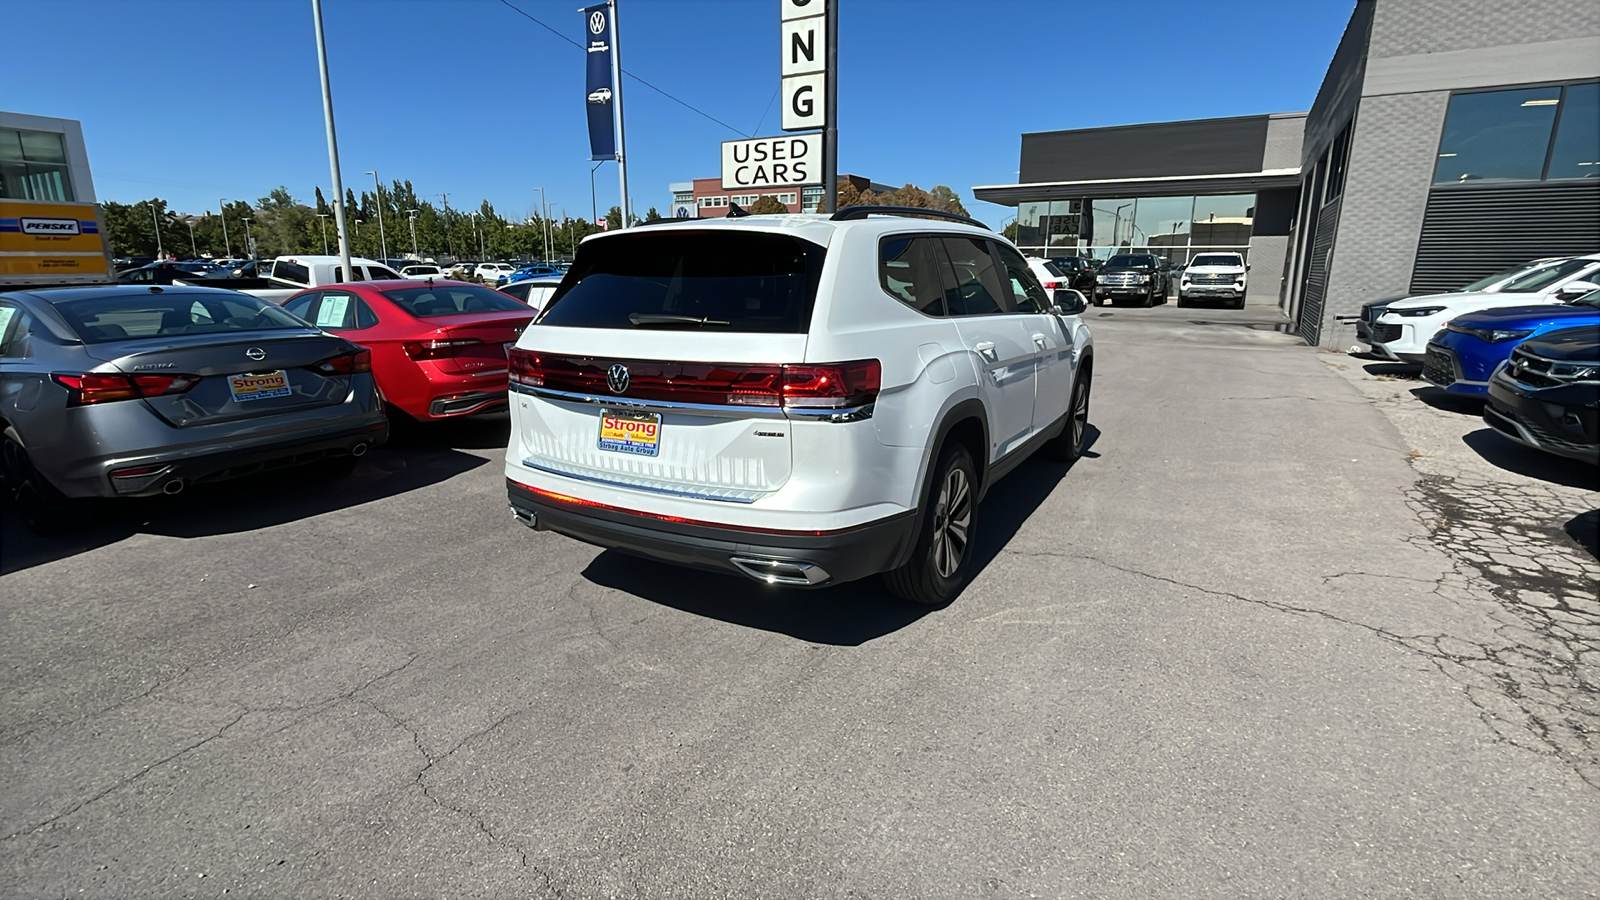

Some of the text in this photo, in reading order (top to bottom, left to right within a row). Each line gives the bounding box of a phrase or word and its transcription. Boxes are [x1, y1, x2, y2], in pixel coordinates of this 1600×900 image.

[791, 0, 815, 118] NG
[733, 139, 809, 164] USED
[735, 161, 808, 185] CARS
[26, 222, 75, 230] PENSKE
[233, 377, 284, 388] Strong
[604, 417, 657, 437] Strong
[600, 443, 619, 451] Strong
[636, 447, 655, 455] Group
